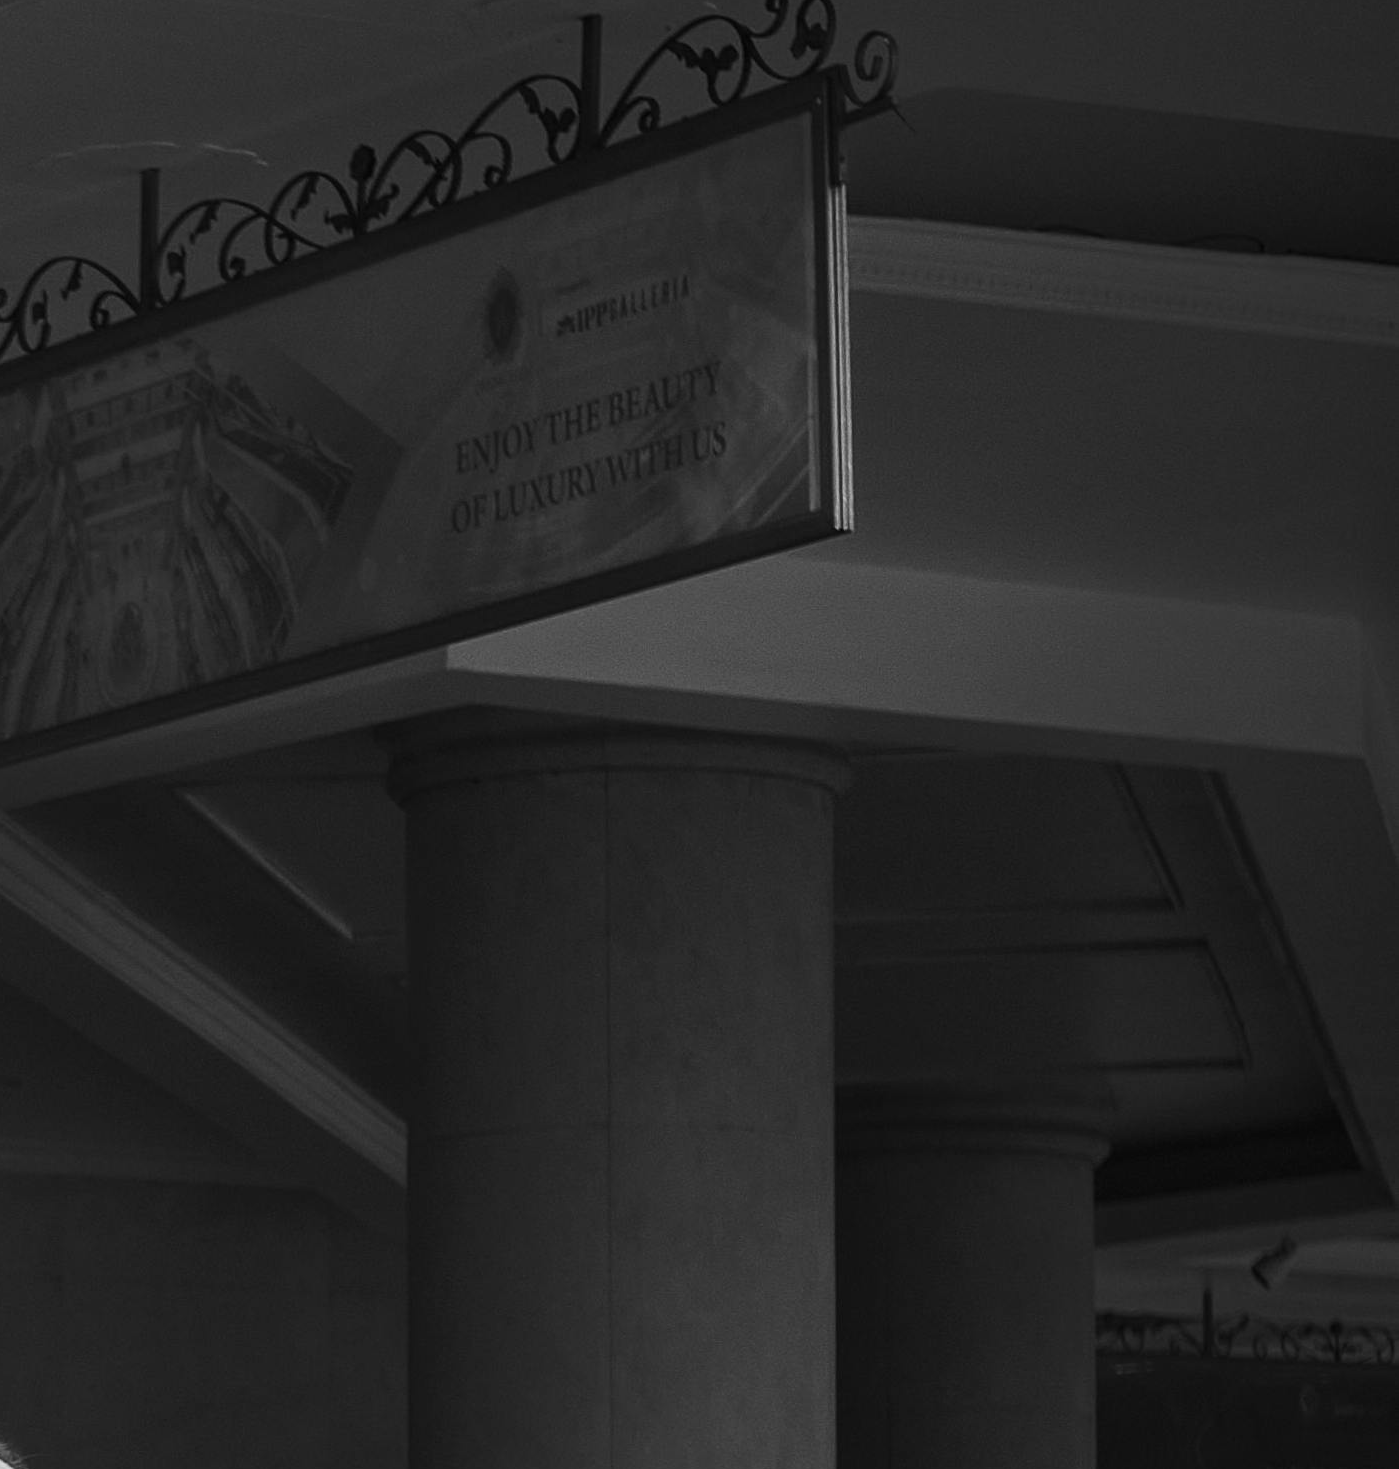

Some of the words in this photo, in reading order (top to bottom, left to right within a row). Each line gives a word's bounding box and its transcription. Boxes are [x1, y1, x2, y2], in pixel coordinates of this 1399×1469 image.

[455, 417, 540, 474] ENJOY
[546, 399, 601, 445] THE
[609, 361, 721, 426] BEAUTY
[451, 494, 488, 534] OF
[493, 459, 600, 522] LUXURY
[606, 432, 684, 486] WITH
[691, 421, 727, 461] US
